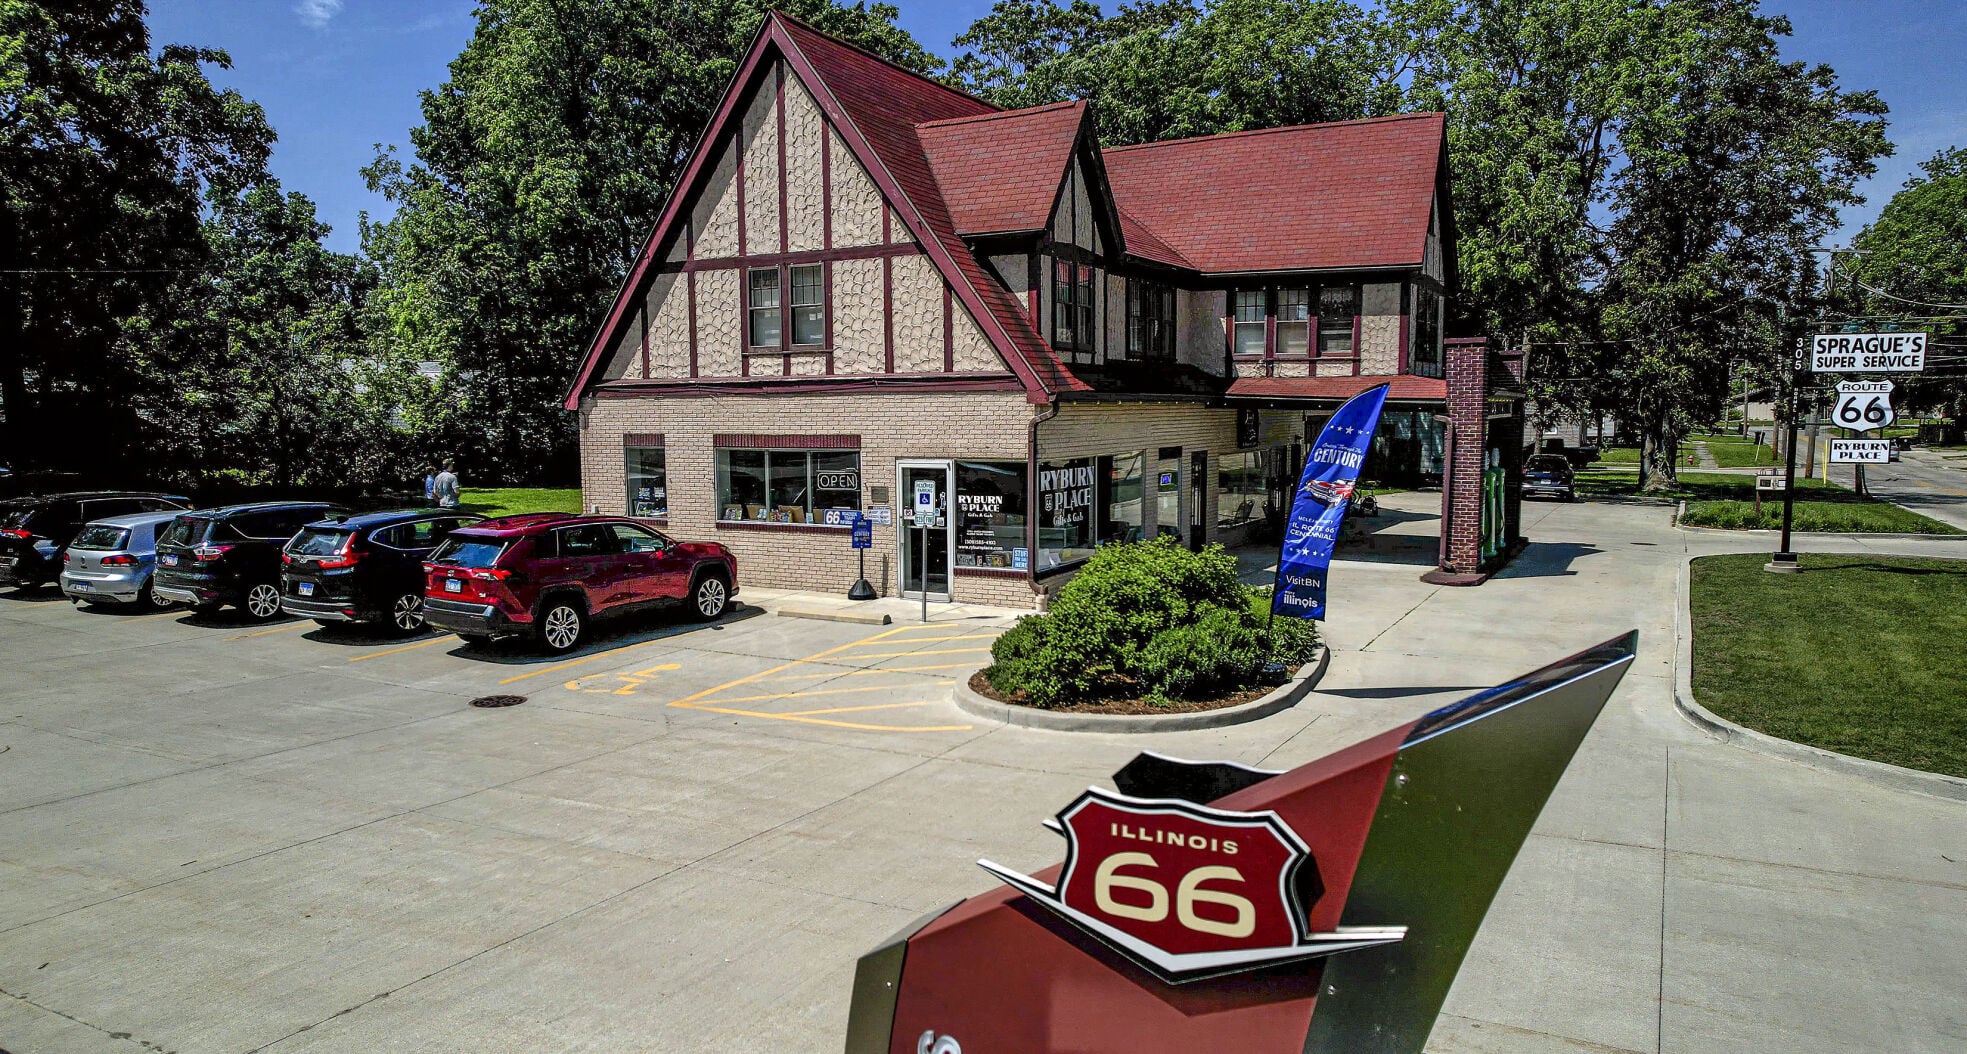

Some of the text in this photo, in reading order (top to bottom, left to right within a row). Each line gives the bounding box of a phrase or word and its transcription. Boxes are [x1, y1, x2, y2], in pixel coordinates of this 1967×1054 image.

[1816, 336, 1923, 354] SPRAGUE'S
[1794, 337, 1804, 370] 305
[1816, 355, 1920, 368] SUPER SERVICE
[1841, 383, 1889, 391] ROUTE
[1840, 396, 1886, 423] 66
[1833, 442, 1889, 451] RYBURN
[1313, 447, 1363, 470] CENTURY
[1839, 452, 1882, 460] PLACE
[820, 475, 855, 487] OPEN
[1040, 465, 1095, 492] RYBURN
[957, 495, 1003, 505] RYBURN
[1054, 487, 1091, 511] PLACE
[969, 503, 1000, 512] PLACE
[826, 511, 840, 524] 66
[1285, 575, 1320, 588] VisitBN
[1283, 594, 1318, 609] illinois
[1110, 822, 1240, 856] ILLINOIS
[1094, 851, 1257, 939] 66
